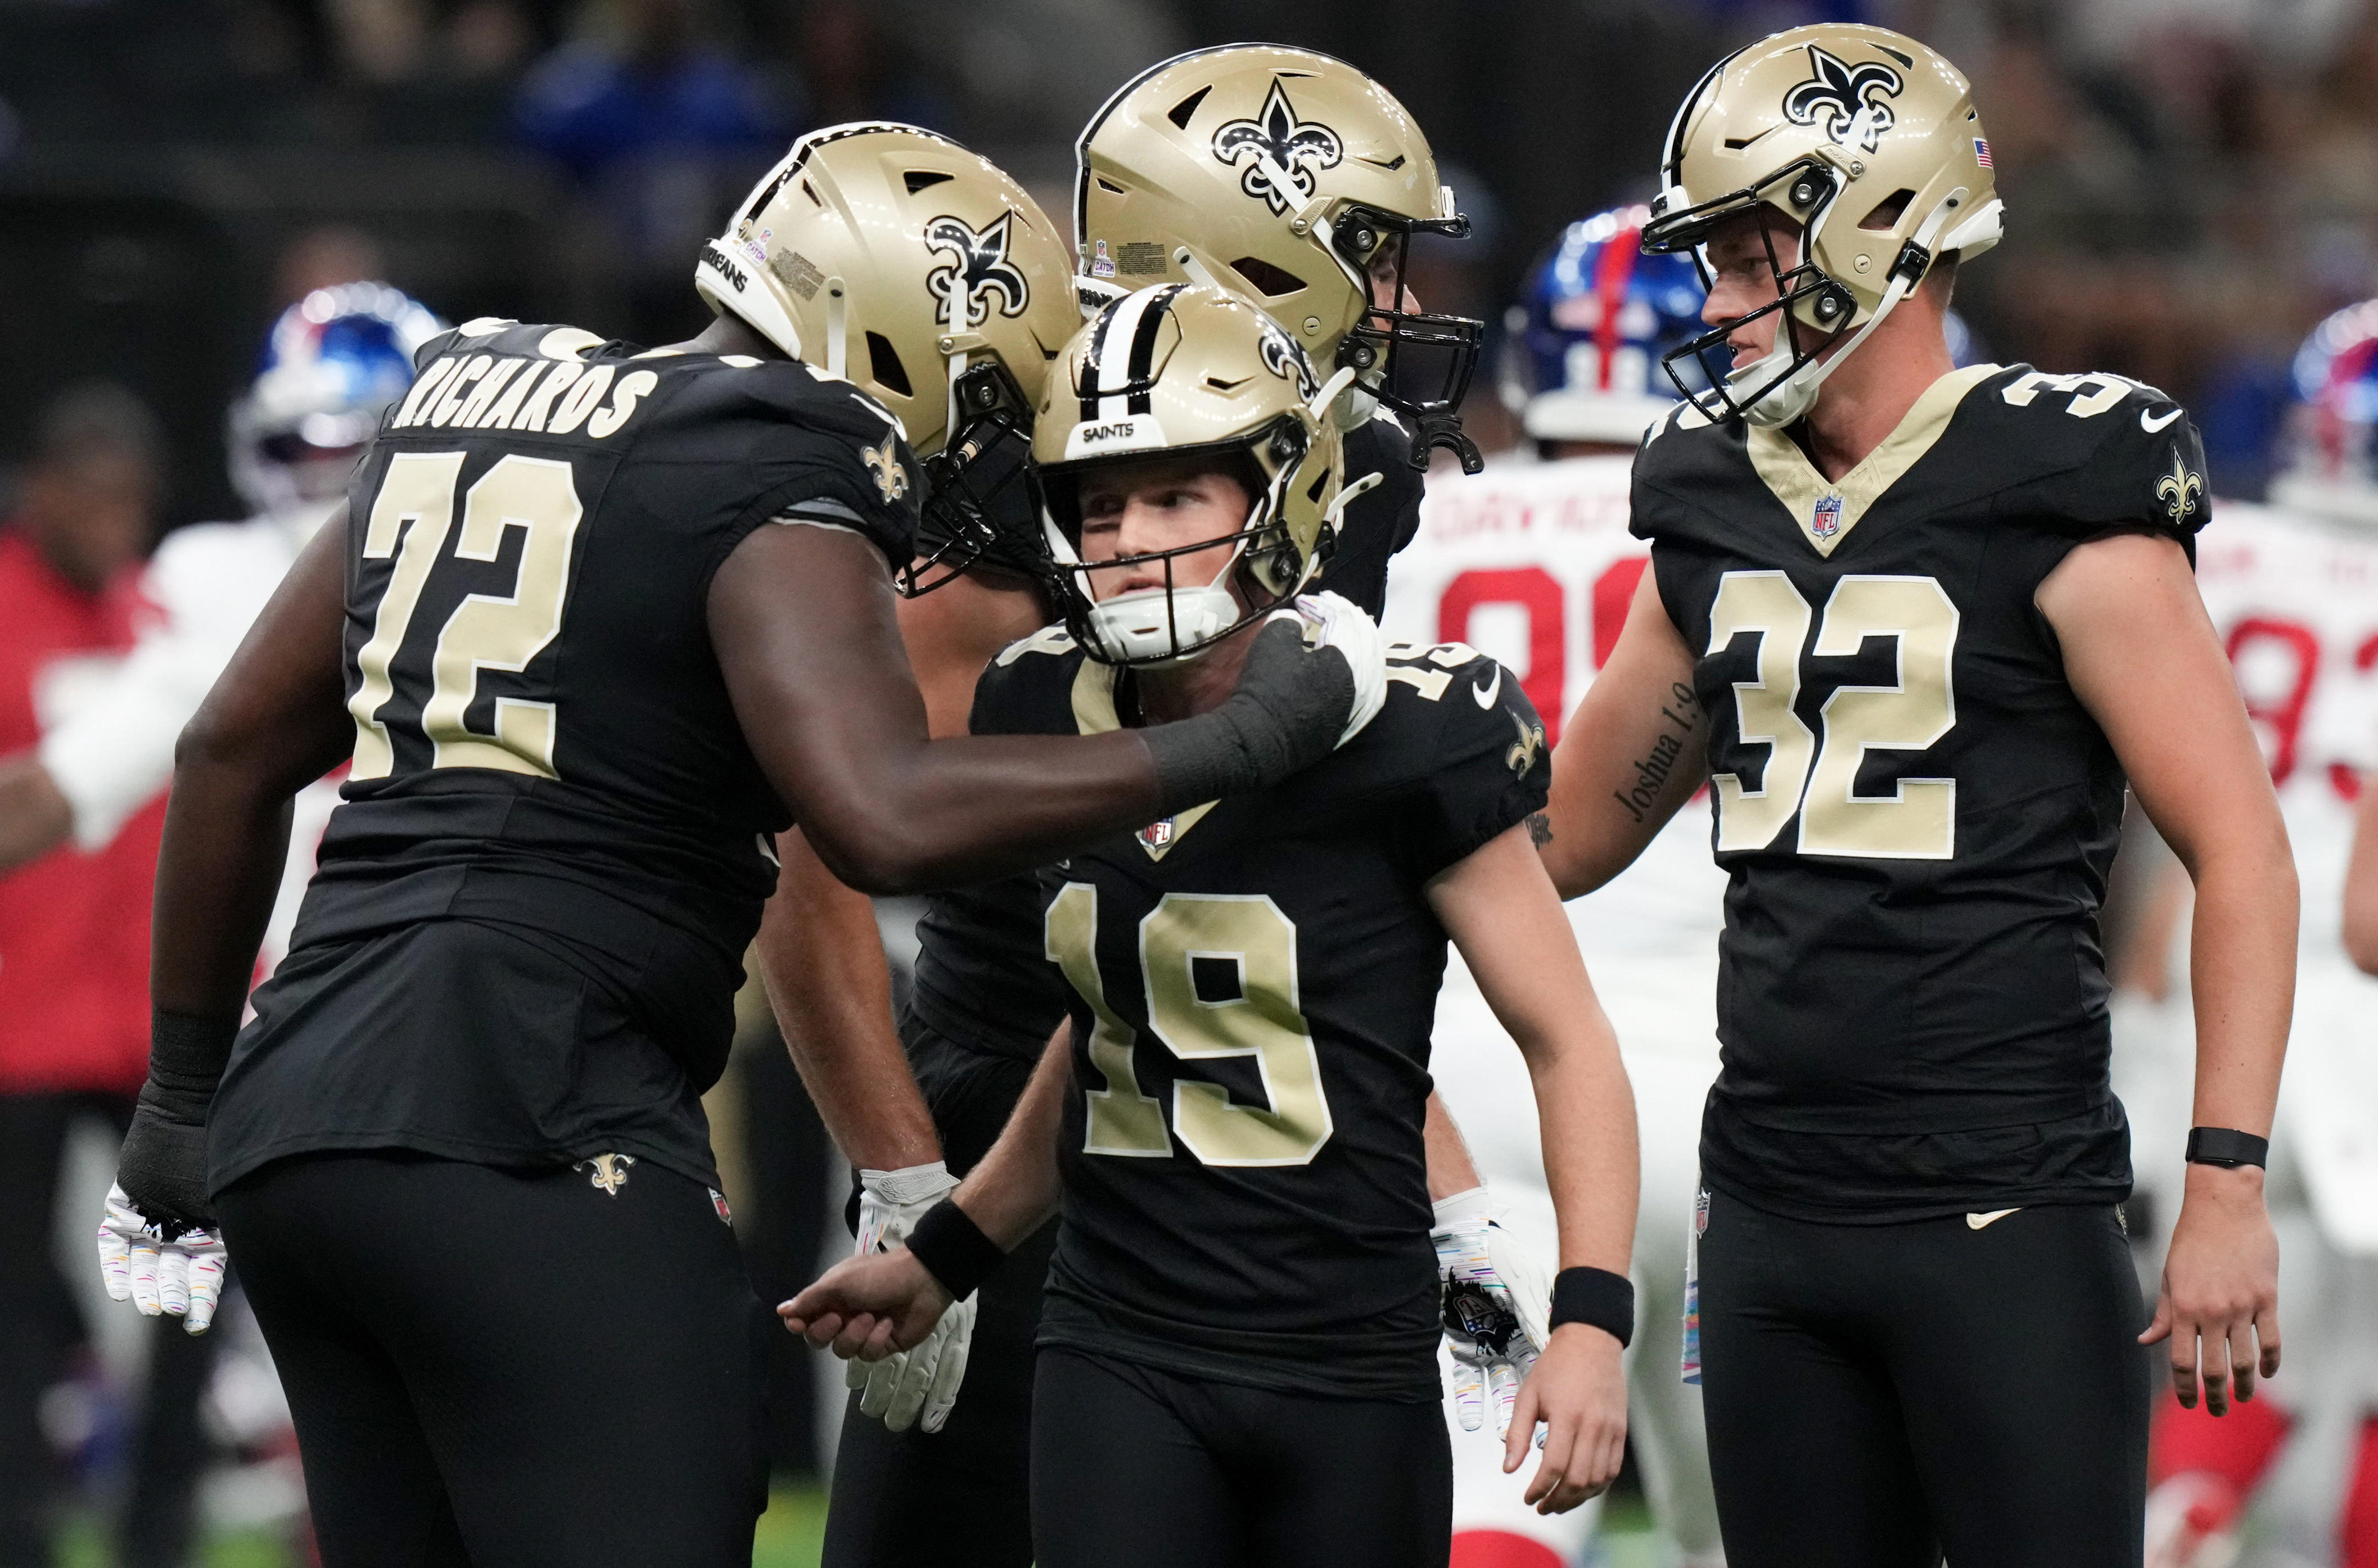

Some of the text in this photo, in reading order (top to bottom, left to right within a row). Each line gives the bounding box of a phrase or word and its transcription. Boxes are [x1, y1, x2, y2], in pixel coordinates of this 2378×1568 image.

[745, 243, 766, 262] CATCH
[1095, 261, 1114, 273] CATCH
[391, 354, 658, 439] RICHARDS
[1083, 423, 1134, 442] SAINTS
[1815, 513, 1835, 531] NFL
[347, 451, 584, 782] 72
[1705, 570, 1961, 860] 32
[1613, 681, 1698, 824] Joshua 1:9
[1145, 824, 1168, 843] NFL
[1044, 880, 1334, 1168] 19
